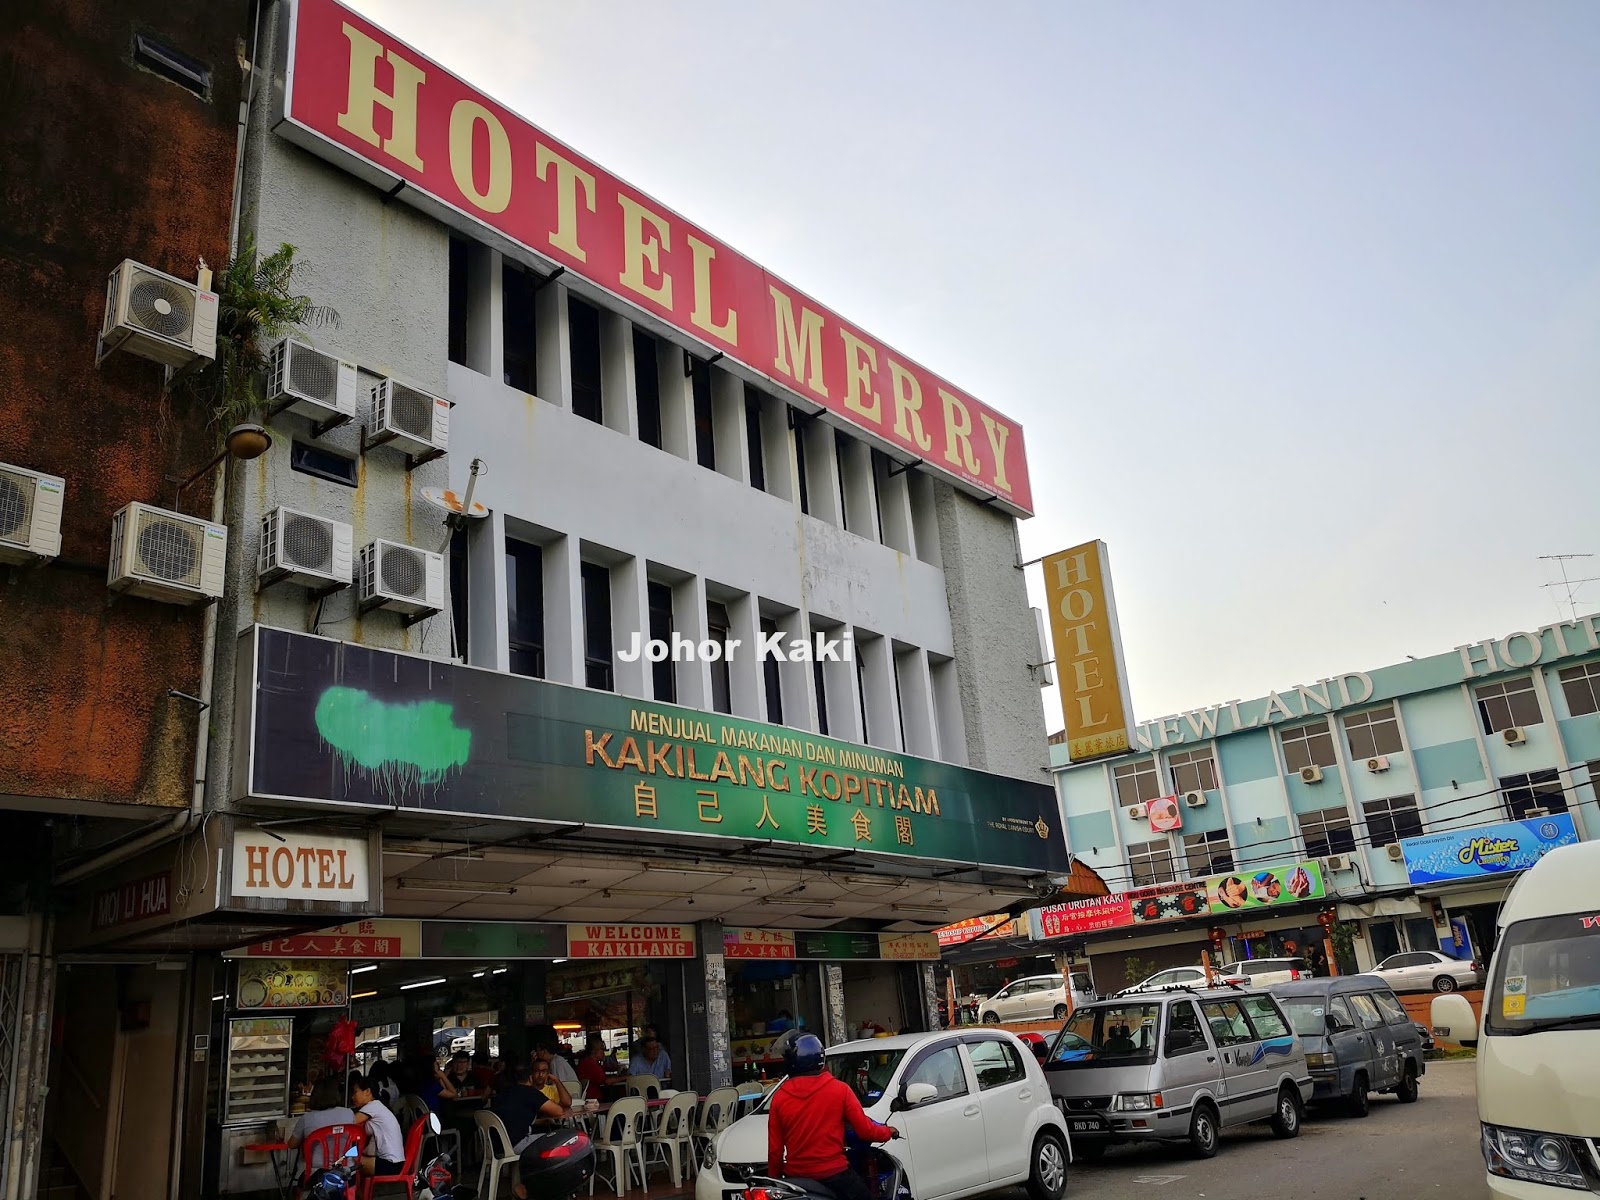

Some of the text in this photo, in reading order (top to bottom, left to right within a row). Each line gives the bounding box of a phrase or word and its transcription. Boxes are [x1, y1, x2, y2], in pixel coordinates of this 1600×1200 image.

[337, 21, 1012, 493] HOTEL MERRY
[1053, 551, 1109, 729] HOTEL
[1136, 671, 1374, 750] NEWLAND
[630, 709, 904, 778] MENJUAL MAKANAN DAN MINUMAN
[584, 729, 941, 817] KAKILANG KOPITIAM
[633, 780, 914, 846] 自己人美食閣
[1458, 837, 1520, 864] Mister
[1476, 855, 1510, 866] Laundry
[245, 846, 355, 890] HOTEL
[140, 876, 168, 915] HUA
[1184, 881, 1207, 890] CENTRE
[1041, 893, 1124, 914] PUSAT URUTAN KAKI
[331, 921, 376, 935] 光臨
[585, 926, 682, 939] WELCOME
[588, 941, 686, 957] KAKILANG
[1087, 1121, 1100, 1130] 740
